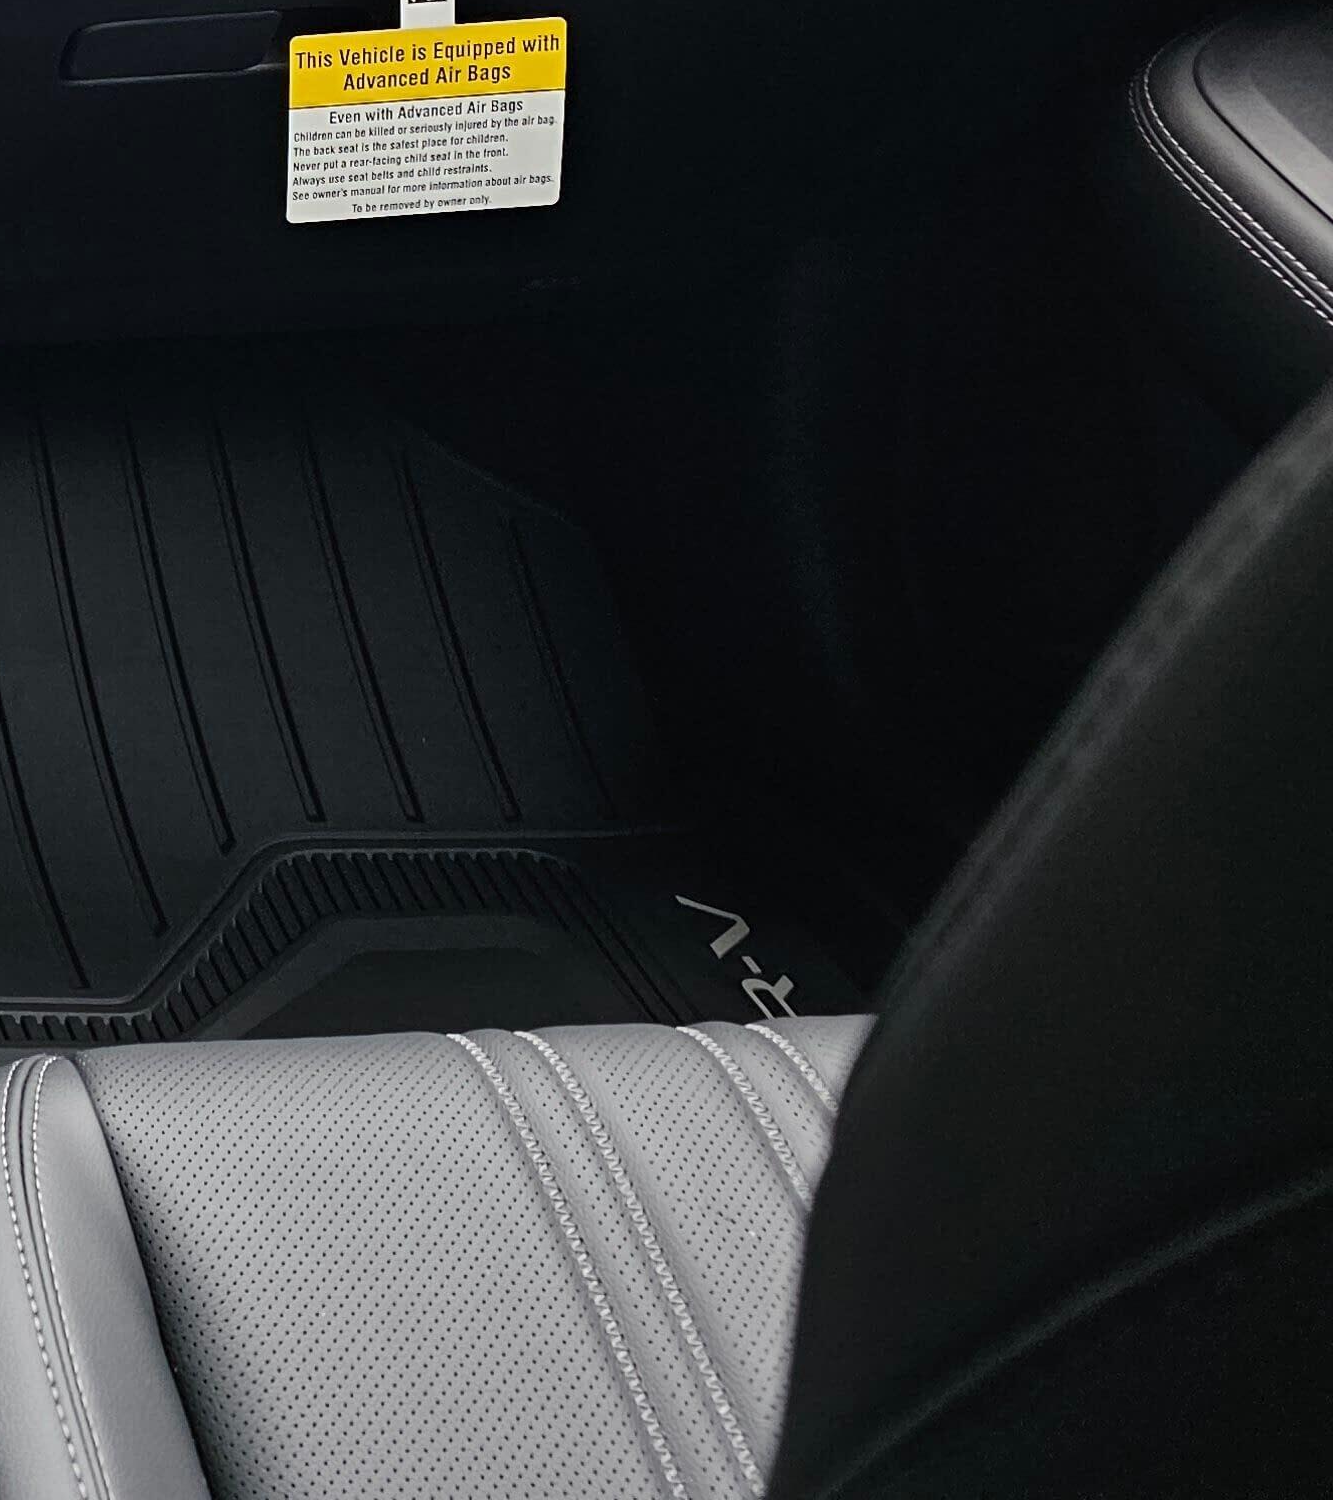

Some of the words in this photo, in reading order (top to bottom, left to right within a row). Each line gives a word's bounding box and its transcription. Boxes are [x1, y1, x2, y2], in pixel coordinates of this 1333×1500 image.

[295, 51, 332, 69] This
[339, 46, 405, 66] Vehicle
[413, 44, 427, 61] is
[433, 37, 515, 61] Equipped
[523, 34, 559, 52] with
[343, 68, 429, 91] Advanced
[436, 66, 461, 84] Air
[468, 65, 511, 83] Bags
[329, 111, 361, 124] Even
[366, 108, 393, 121] with
[397, 102, 462, 119] Advanced
[467, 101, 486, 114] Air
[491, 100, 523, 114] Bags
[294, 131, 332, 142] Children
[335, 131, 351, 140] can
[355, 128, 366, 138] be
[369, 126, 394, 136] killed
[398, 126, 407, 135] or
[410, 122, 452, 133] seriously
[455, 120, 488, 132] injured
[491, 118, 501, 130] by
[505, 118, 519, 127] the
[522, 116, 535, 126] air
[294, 147, 311, 157] The
[314, 146, 335, 156] back
[339, 144, 358, 154] seat
[361, 142, 369, 152] is
[373, 142, 387, 151] the
[391, 140, 419, 150] safest
[422, 138, 447, 149] place
[451, 136, 463, 146] for
[467, 134, 509, 144] children.
[293, 162, 321, 172] Never
[323, 160, 338, 172] put
[341, 160, 347, 168] a
[349, 156, 401, 168] rear-facing
[405, 154, 427, 164] child
[431, 152, 451, 162] seat
[454, 150, 463, 160] in
[465, 149, 481, 158] the
[483, 148, 509, 158] front.
[293, 176, 325, 186] Always
[329, 175, 345, 184] use
[348, 172, 368, 182] seat
[371, 170, 393, 180] belts
[397, 168, 414, 178] and
[417, 167, 440, 177] child
[443, 164, 491, 175] restraints.
[293, 192, 309, 200] See
[313, 188, 347, 199] owner's
[351, 186, 385, 196] manual
[387, 184, 400, 194] for
[403, 182, 427, 192] more
[429, 179, 483, 190] information
[485, 176, 511, 186] about
[513, 176, 527, 184] air
[351, 204, 363, 213] To
[365, 202, 377, 212] be
[379, 200, 421, 211] removed
[424, 199, 435, 208] by
[437, 197, 466, 207] owner
